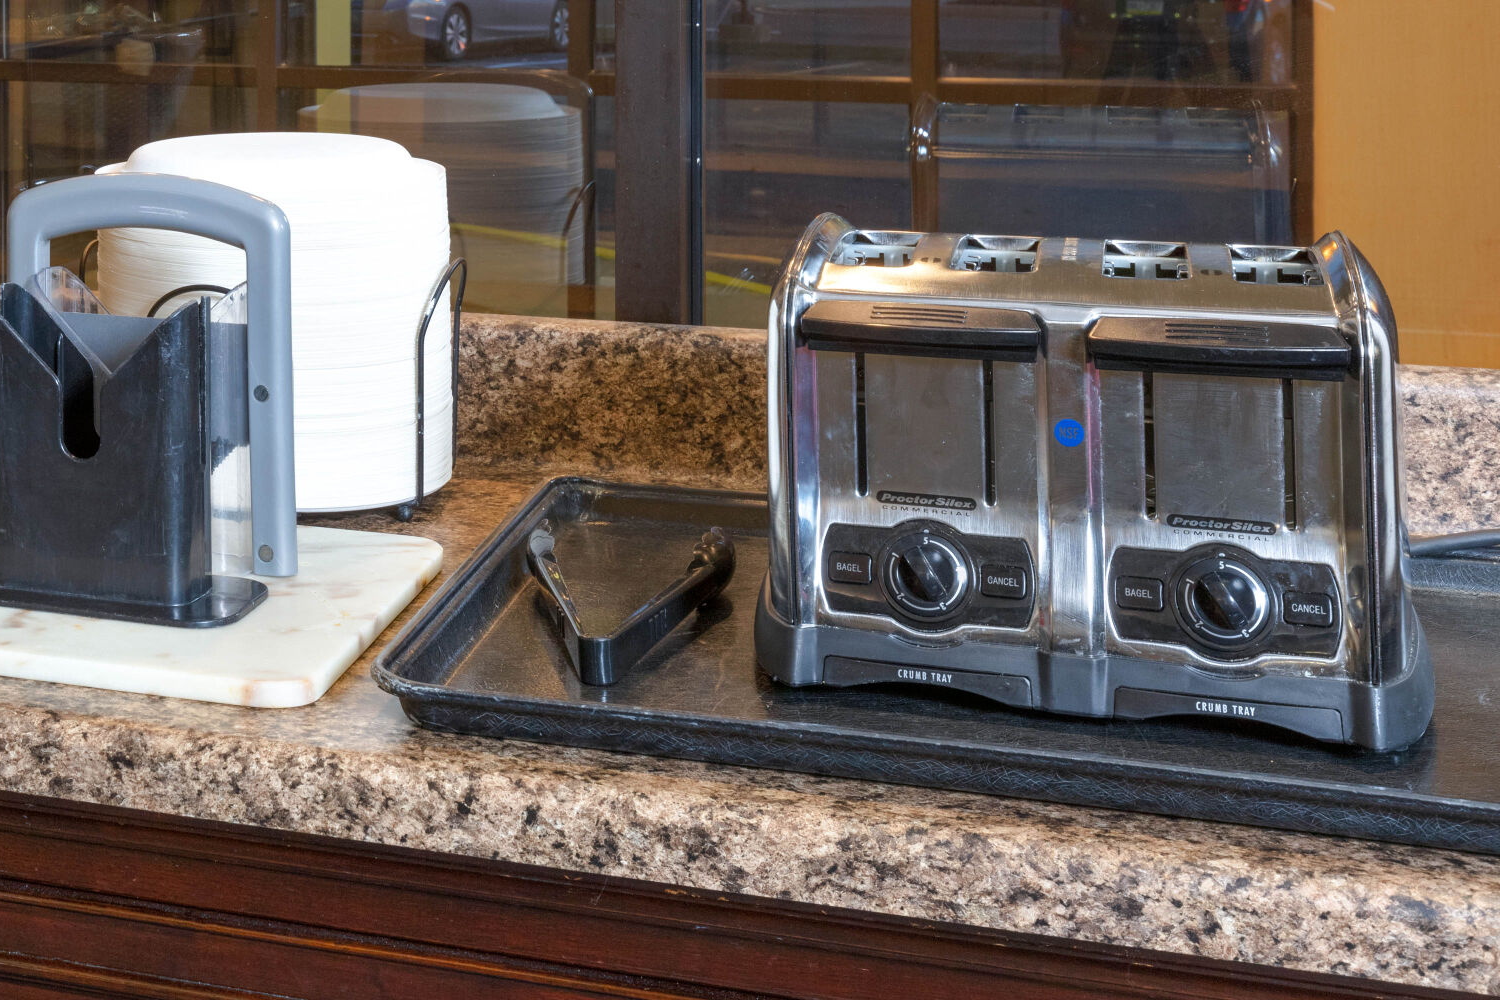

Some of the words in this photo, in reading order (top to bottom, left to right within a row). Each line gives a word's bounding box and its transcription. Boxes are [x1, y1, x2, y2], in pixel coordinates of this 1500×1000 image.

[882, 505, 971, 517] COMMERCIAL
[923, 537, 929, 545] 5
[1173, 529, 1269, 542] COMMERCIAL
[836, 562, 863, 573] BAGEL
[1218, 561, 1225, 570] 5
[987, 575, 1020, 587] CANCEL
[1125, 587, 1153, 599] BAGEL
[939, 602, 947, 611] 3
[1291, 603, 1327, 615] CANCEL
[1241, 629, 1250, 638] 3
[897, 669, 927, 681] CRUMB
[931, 672, 952, 683] TRAY
[1195, 701, 1228, 713] CRUMB
[1232, 705, 1256, 717] TRAY
